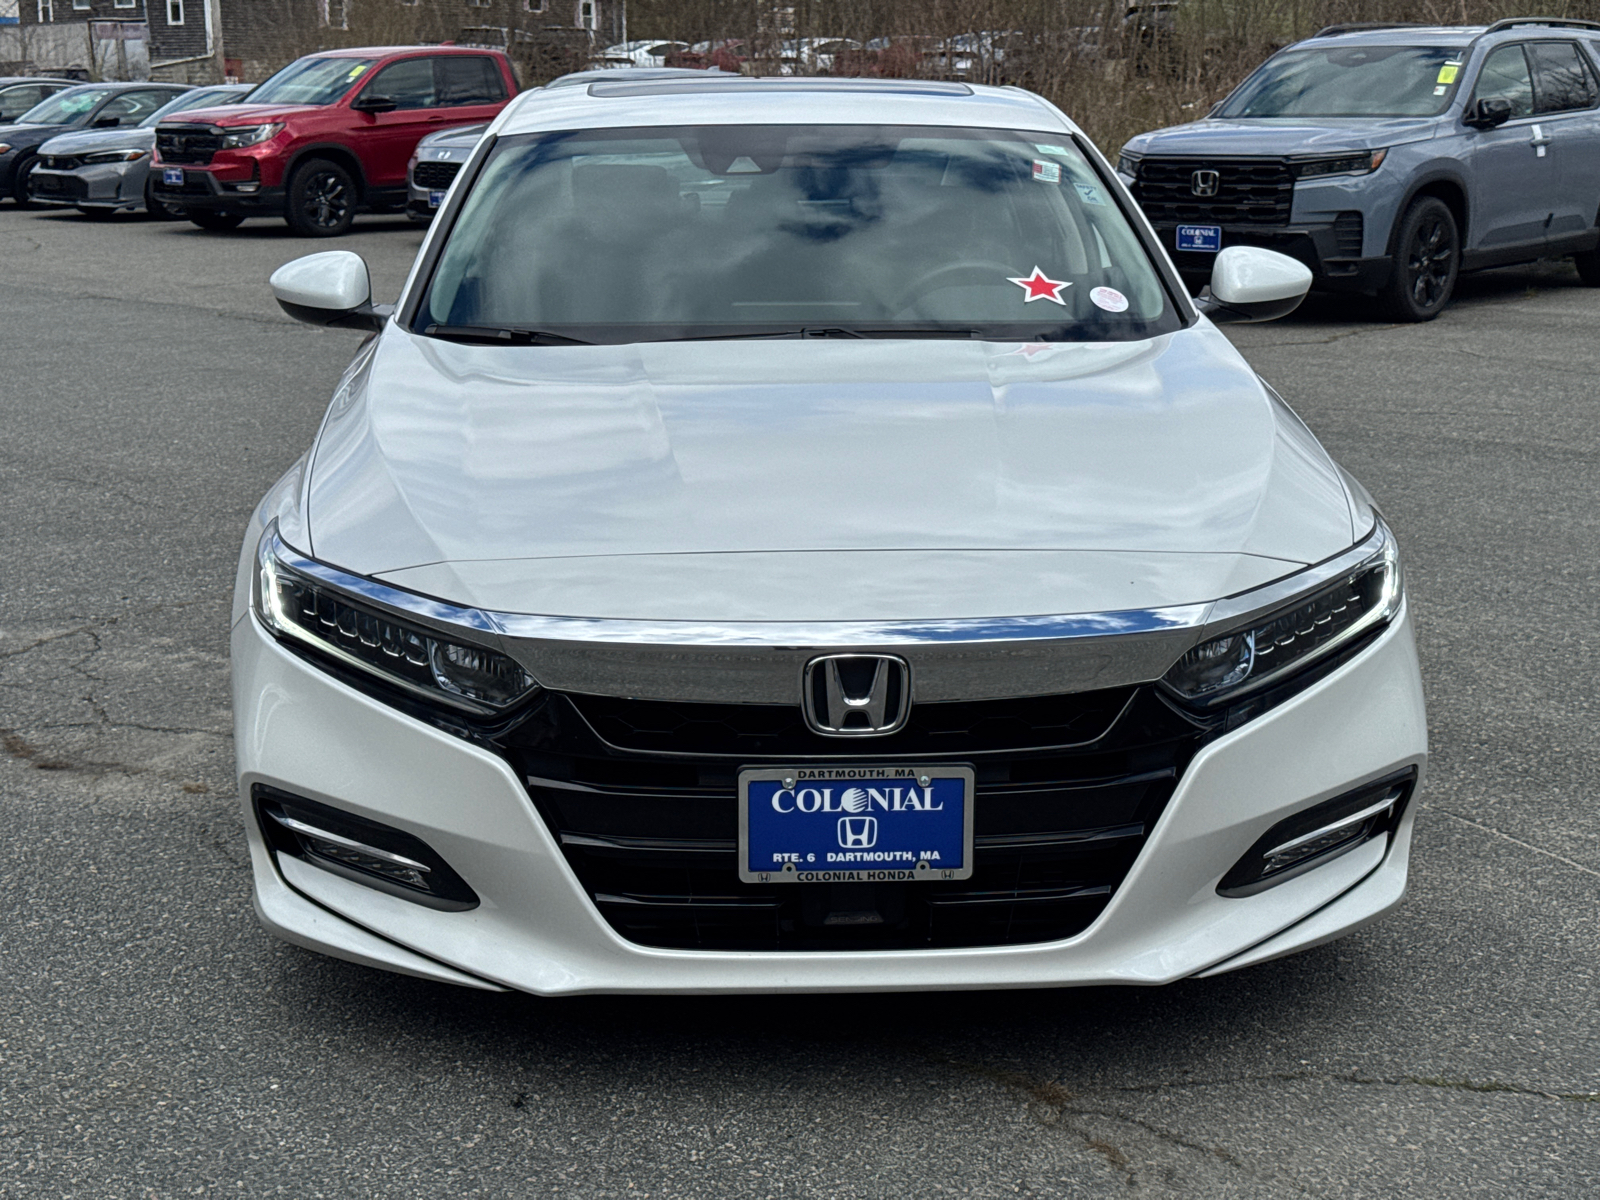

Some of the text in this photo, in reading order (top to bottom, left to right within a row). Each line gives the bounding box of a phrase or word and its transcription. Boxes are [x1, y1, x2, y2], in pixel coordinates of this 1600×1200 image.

[797, 769, 915, 779] DARTMOUTH, MA
[771, 787, 943, 813] COLONIAL
[773, 850, 941, 862] RTE. 6 DARTMOUTH, MA
[797, 871, 915, 881] COLONIAL HONDA
